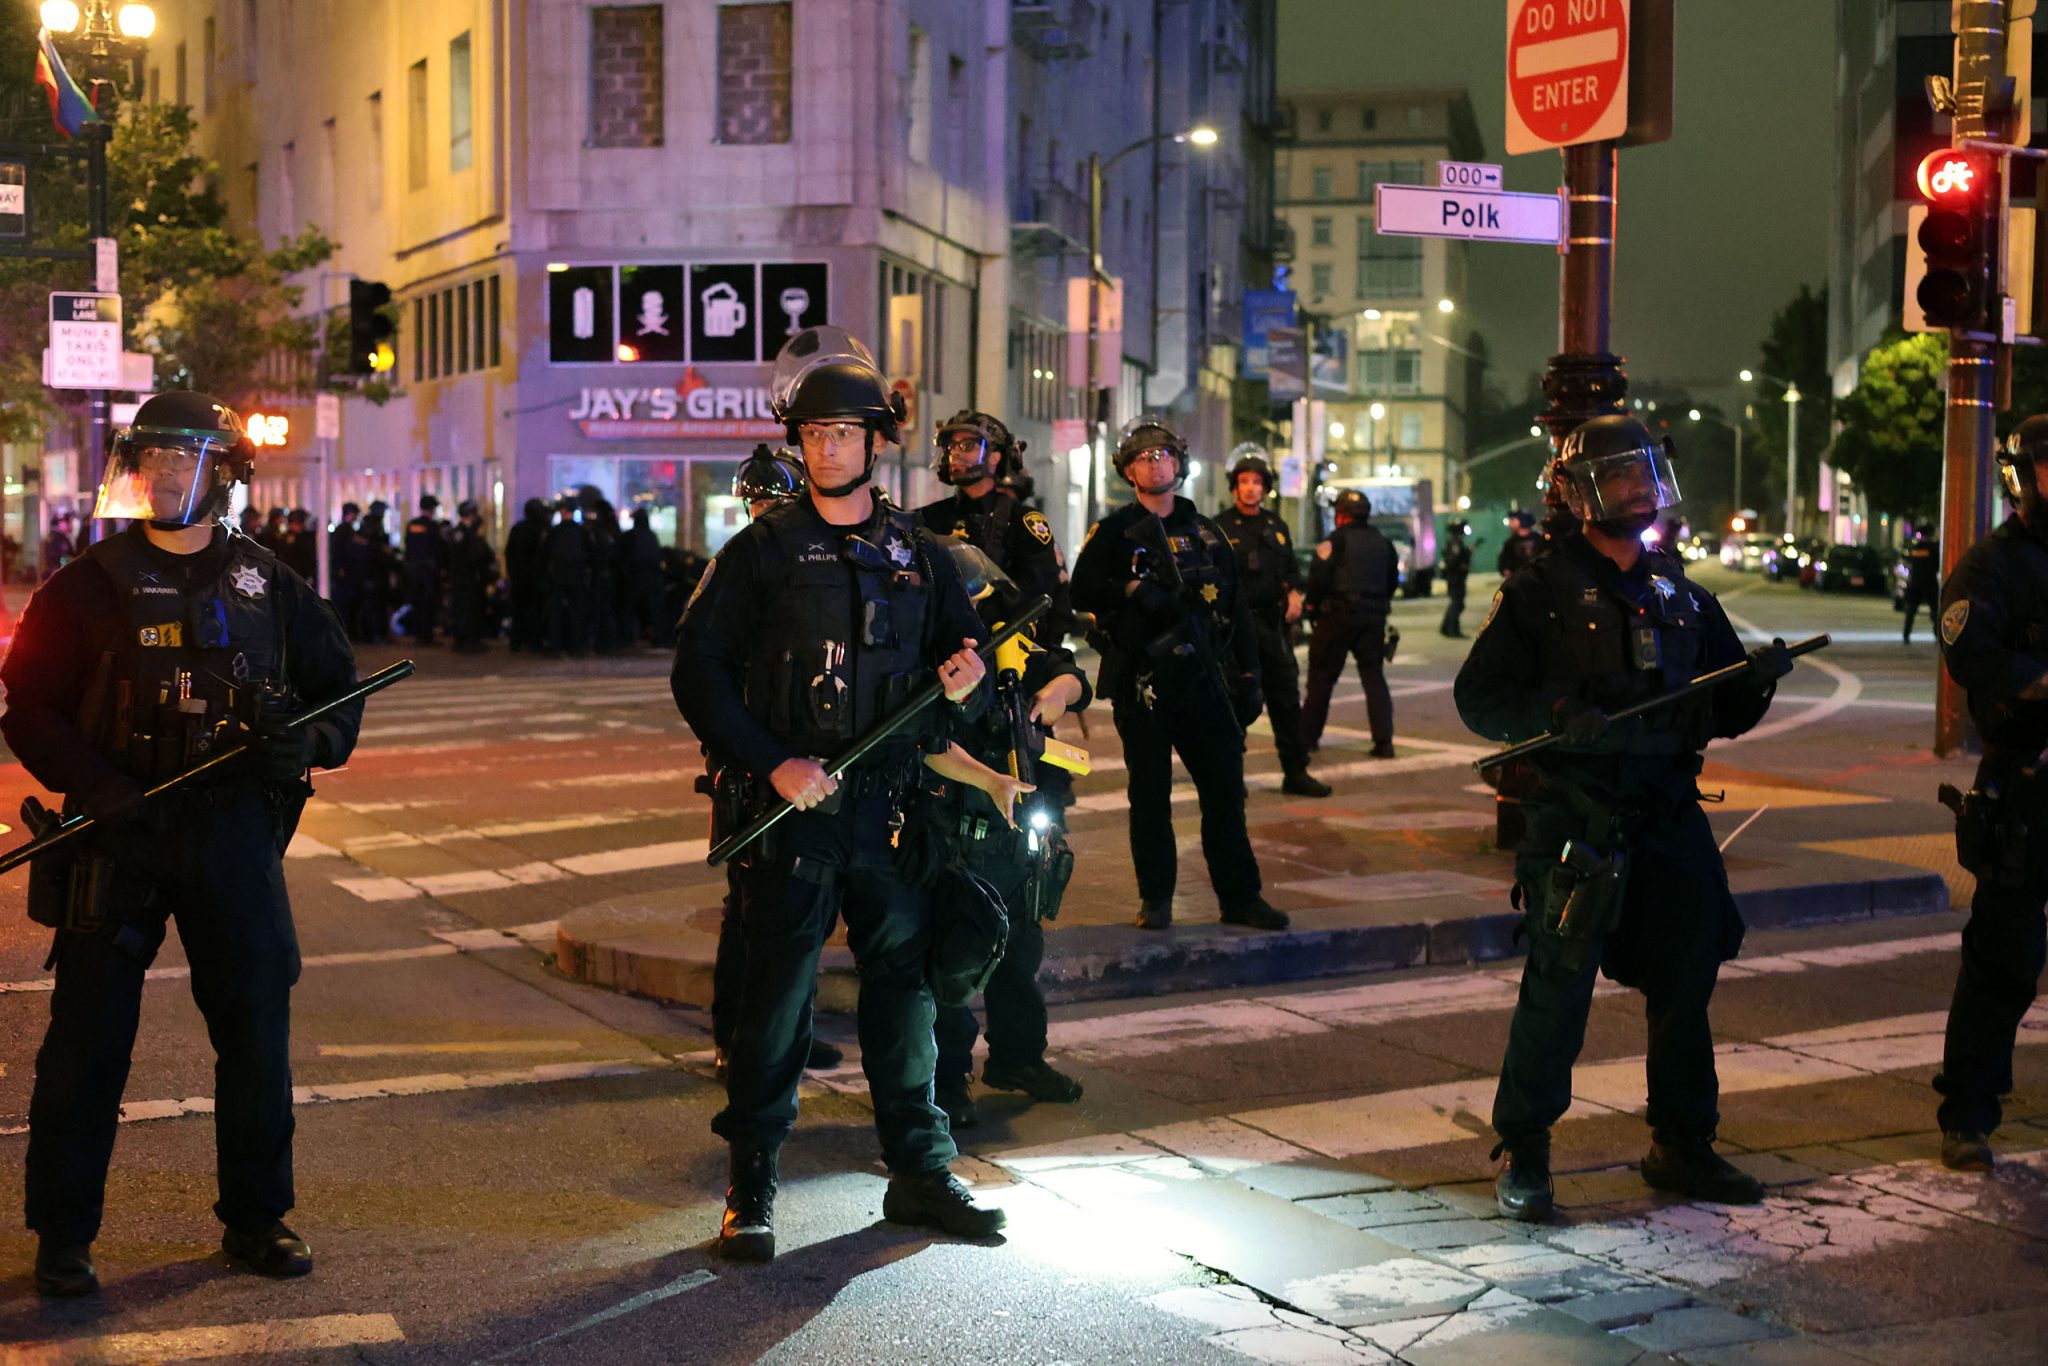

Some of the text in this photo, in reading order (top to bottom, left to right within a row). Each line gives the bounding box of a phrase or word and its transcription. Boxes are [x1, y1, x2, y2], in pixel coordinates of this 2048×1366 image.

[1526, 0, 1607, 34] DO NOT
[1532, 75, 1598, 112] ENTER
[1445, 166, 1483, 185] 000
[1442, 200, 1500, 229] Polk
[72, 298, 97, 309] LEFT
[72, 310, 98, 320] LANE
[61, 327, 97, 337] MUNI
[67, 355, 107, 366] ONLY
[567, 387, 775, 420] JAY'S GRIL
